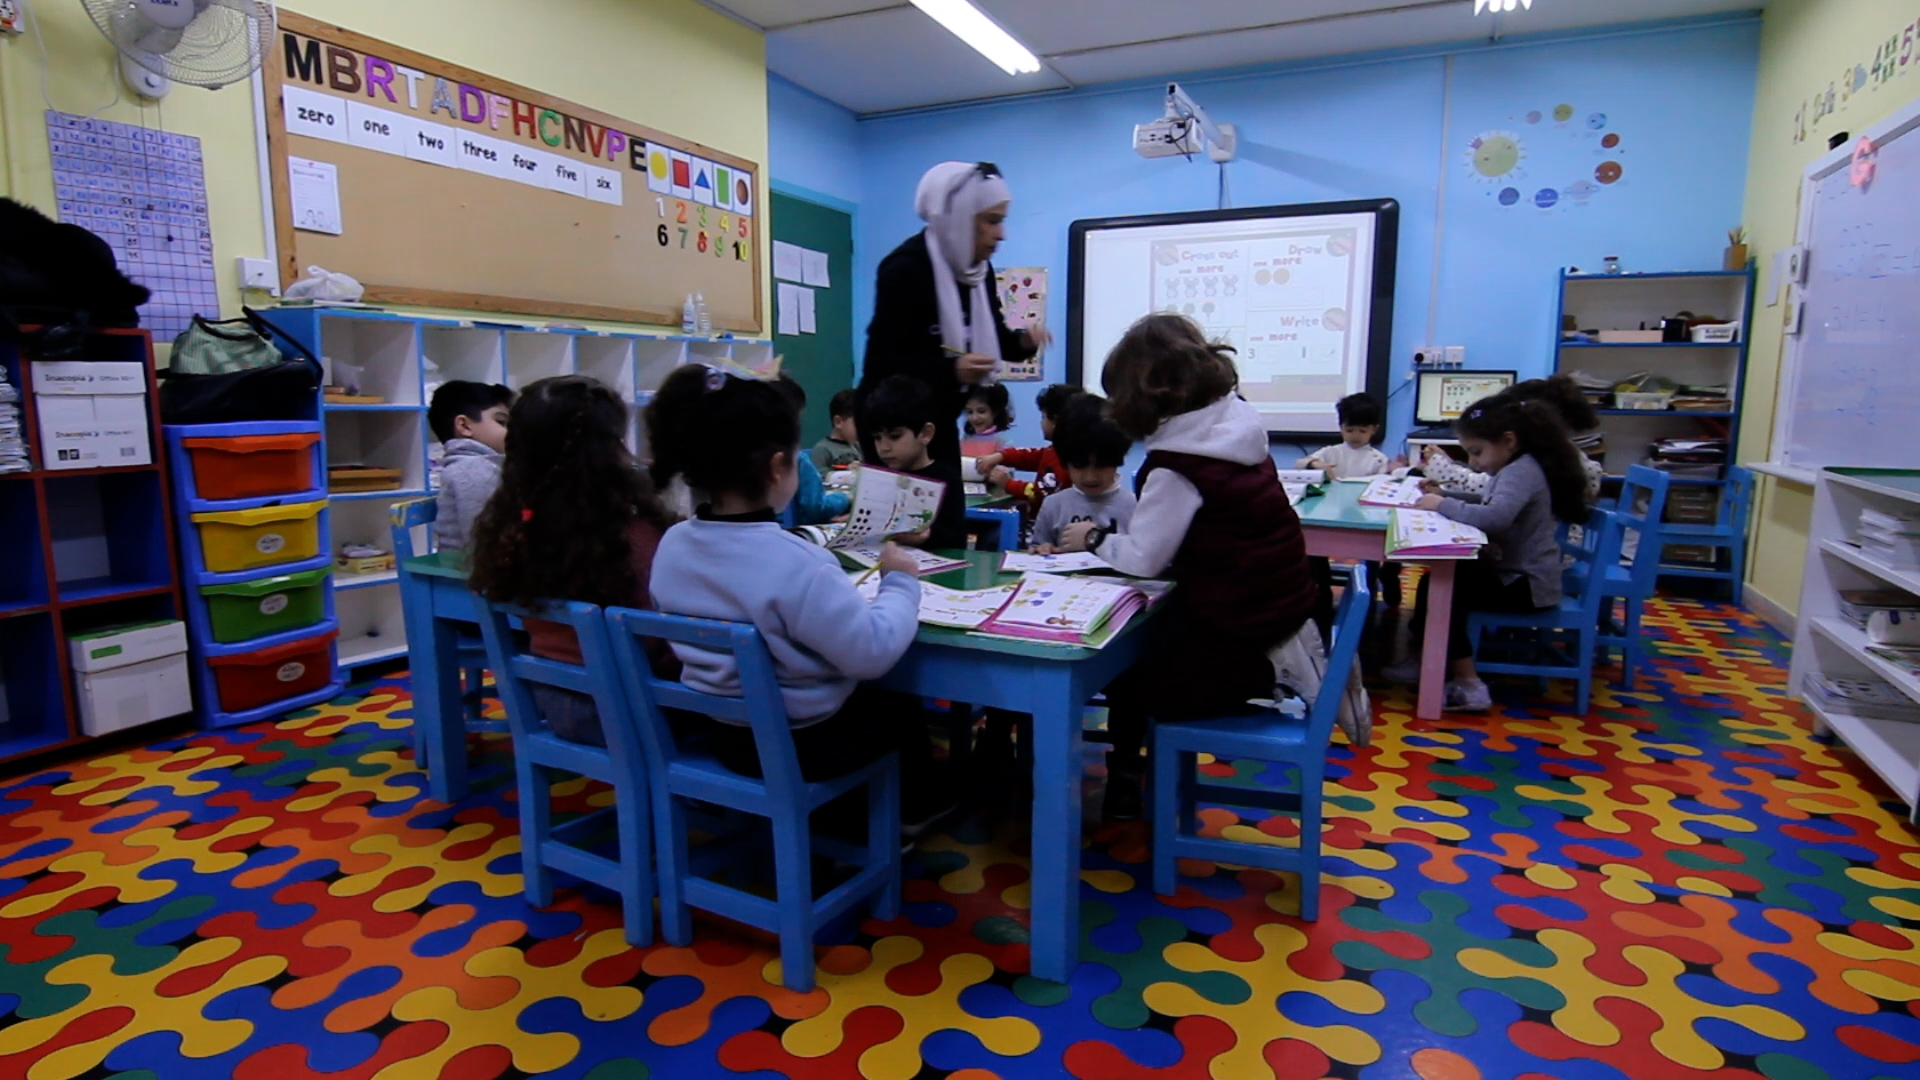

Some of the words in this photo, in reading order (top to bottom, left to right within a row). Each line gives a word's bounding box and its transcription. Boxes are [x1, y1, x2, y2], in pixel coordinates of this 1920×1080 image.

[297, 106, 335, 126] zero
[363, 120, 390, 136] one
[417, 131, 444, 150] two
[462, 140, 498, 162] three
[512, 154, 538, 171] four
[555, 165, 577, 182] five
[596, 176, 612, 190] six
[656, 197, 665, 218] 1
[676, 201, 688, 224] 2
[697, 206, 708, 227] 3
[719, 213, 730, 232] 4
[738, 217, 748, 238] 5
[657, 224, 669, 246] 6
[678, 227, 688, 249] 7
[697, 230, 708, 253] 8
[714, 236, 725, 257] 9
[732, 241, 749, 261] 10
[1280, 315, 1319, 328] Write
[1247, 348, 1255, 359] 3
